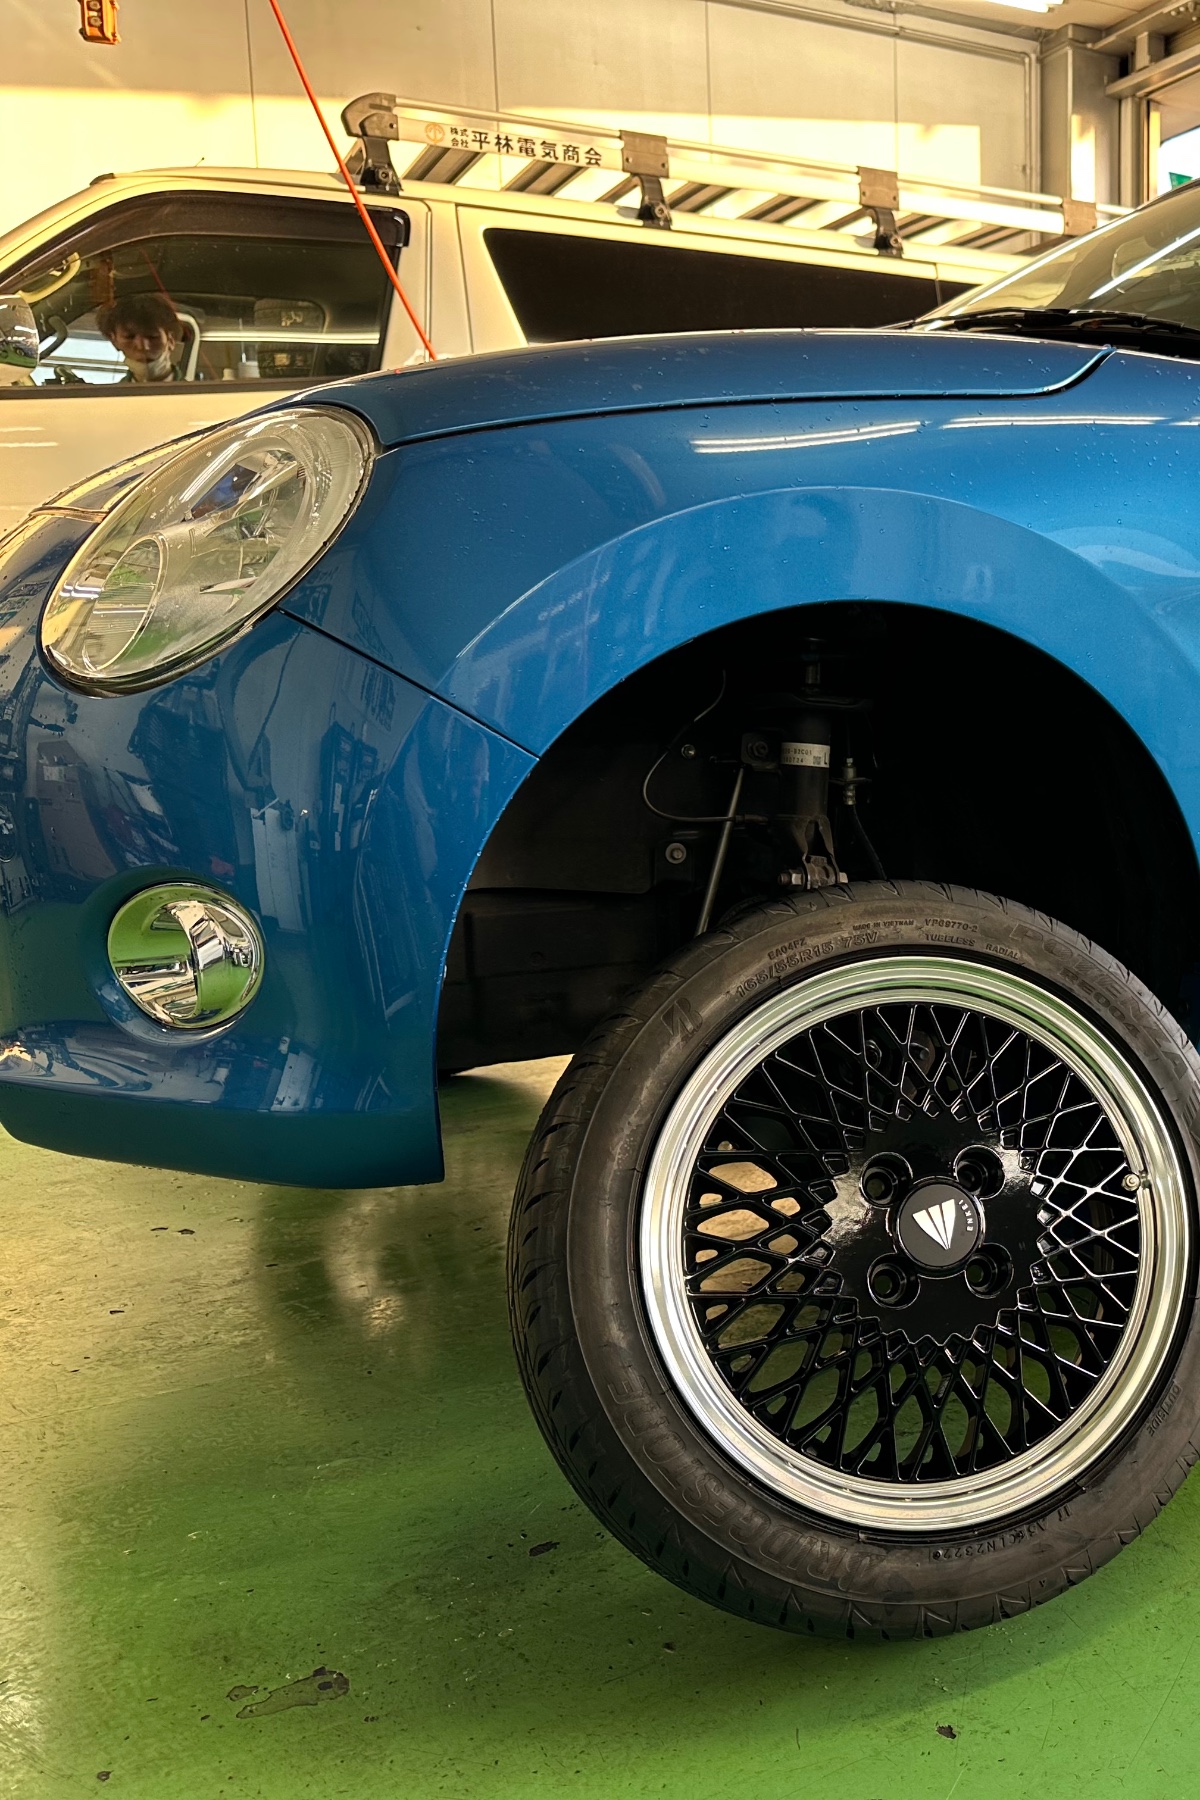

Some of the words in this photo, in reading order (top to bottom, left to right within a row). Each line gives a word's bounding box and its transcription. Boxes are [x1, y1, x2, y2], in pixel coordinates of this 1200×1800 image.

[450, 127, 469, 138] 株式
[450, 138, 469, 148] 会社
[471, 130, 603, 167] 平林電気商会
[736, 940, 835, 999] 165/55R15
[842, 931, 878, 949] 75V
[925, 932, 976, 947] TUBELESS
[985, 942, 1019, 961] RADIAL
[1009, 923, 1193, 1080] POTENZA
[1058, 966, 1142, 1039] RE004
[958, 1199, 974, 1232] ENKEI
[605, 1372, 888, 1597] BRIDGESTONE
